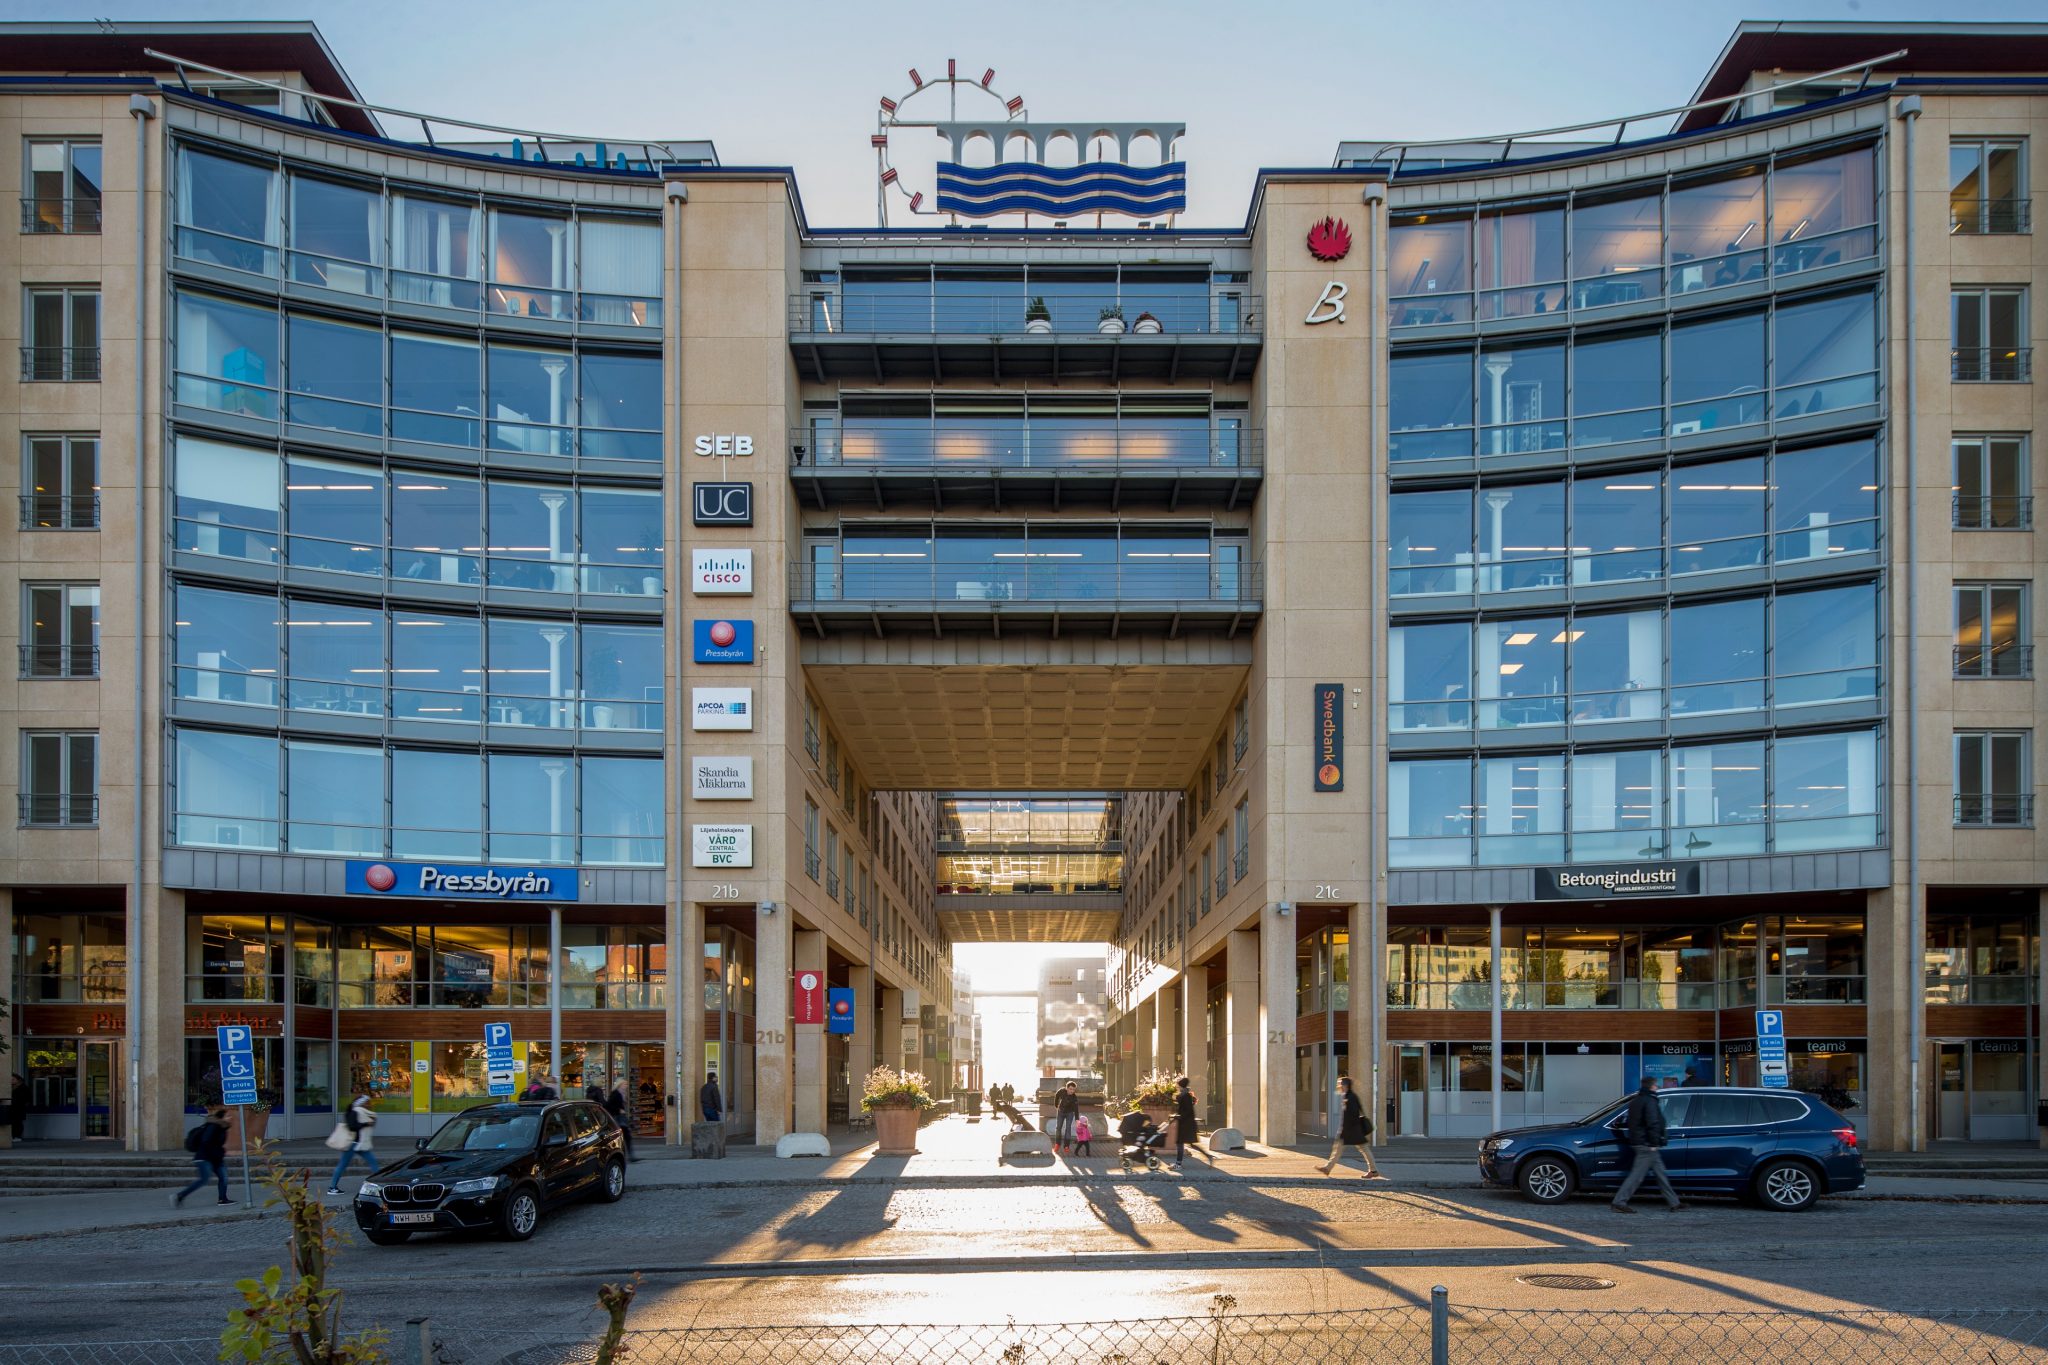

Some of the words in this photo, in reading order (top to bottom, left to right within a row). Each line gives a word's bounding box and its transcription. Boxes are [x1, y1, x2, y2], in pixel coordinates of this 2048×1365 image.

[694, 433, 754, 458] SEB
[699, 489, 745, 516] UC
[703, 574, 742, 584] CISCO
[705, 648, 744, 660] Pressbyrån
[1323, 690, 1336, 762] Swedbank
[698, 766, 739, 778] Skandia
[698, 778, 746, 789] Mäklarna
[708, 833, 736, 845] VÅRD
[712, 854, 733, 864] BVC
[419, 866, 551, 896] Pressbyrån
[1559, 868, 1677, 889] Betongindustri
[712, 884, 739, 899] 21b
[1315, 885, 1340, 899] 21c
[1763, 1013, 1778, 1034] P
[226, 1028, 245, 1049] P
[492, 1026, 507, 1045] P
[1662, 1043, 1700, 1055] team8
[1725, 1042, 1753, 1053] team8
[1807, 1041, 1846, 1052] team8
[394, 1215, 409, 1223] NWH
[416, 1214, 431, 1222] 155
